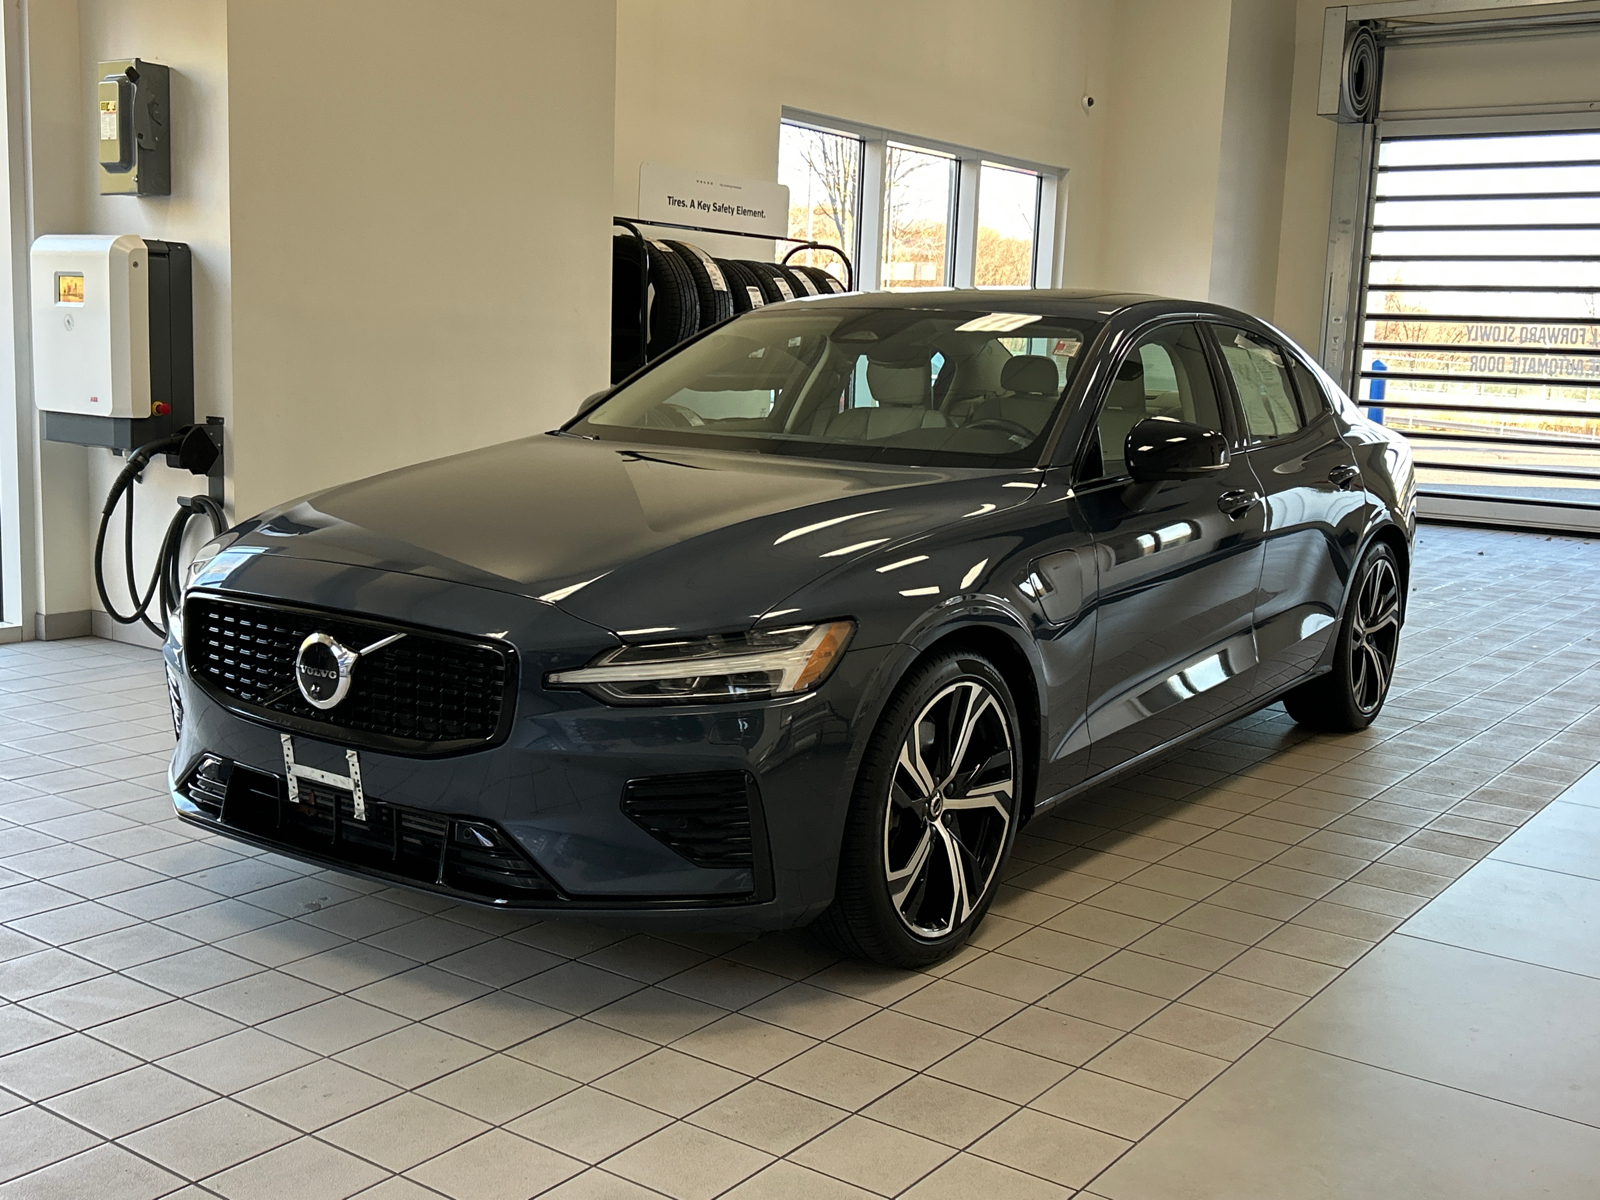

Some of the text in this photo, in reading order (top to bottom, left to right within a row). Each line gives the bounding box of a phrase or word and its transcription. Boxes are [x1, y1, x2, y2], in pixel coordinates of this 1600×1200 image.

[667, 195, 766, 219] Tires. A Key Safety Element.
[300, 664, 338, 680] VOLVO
